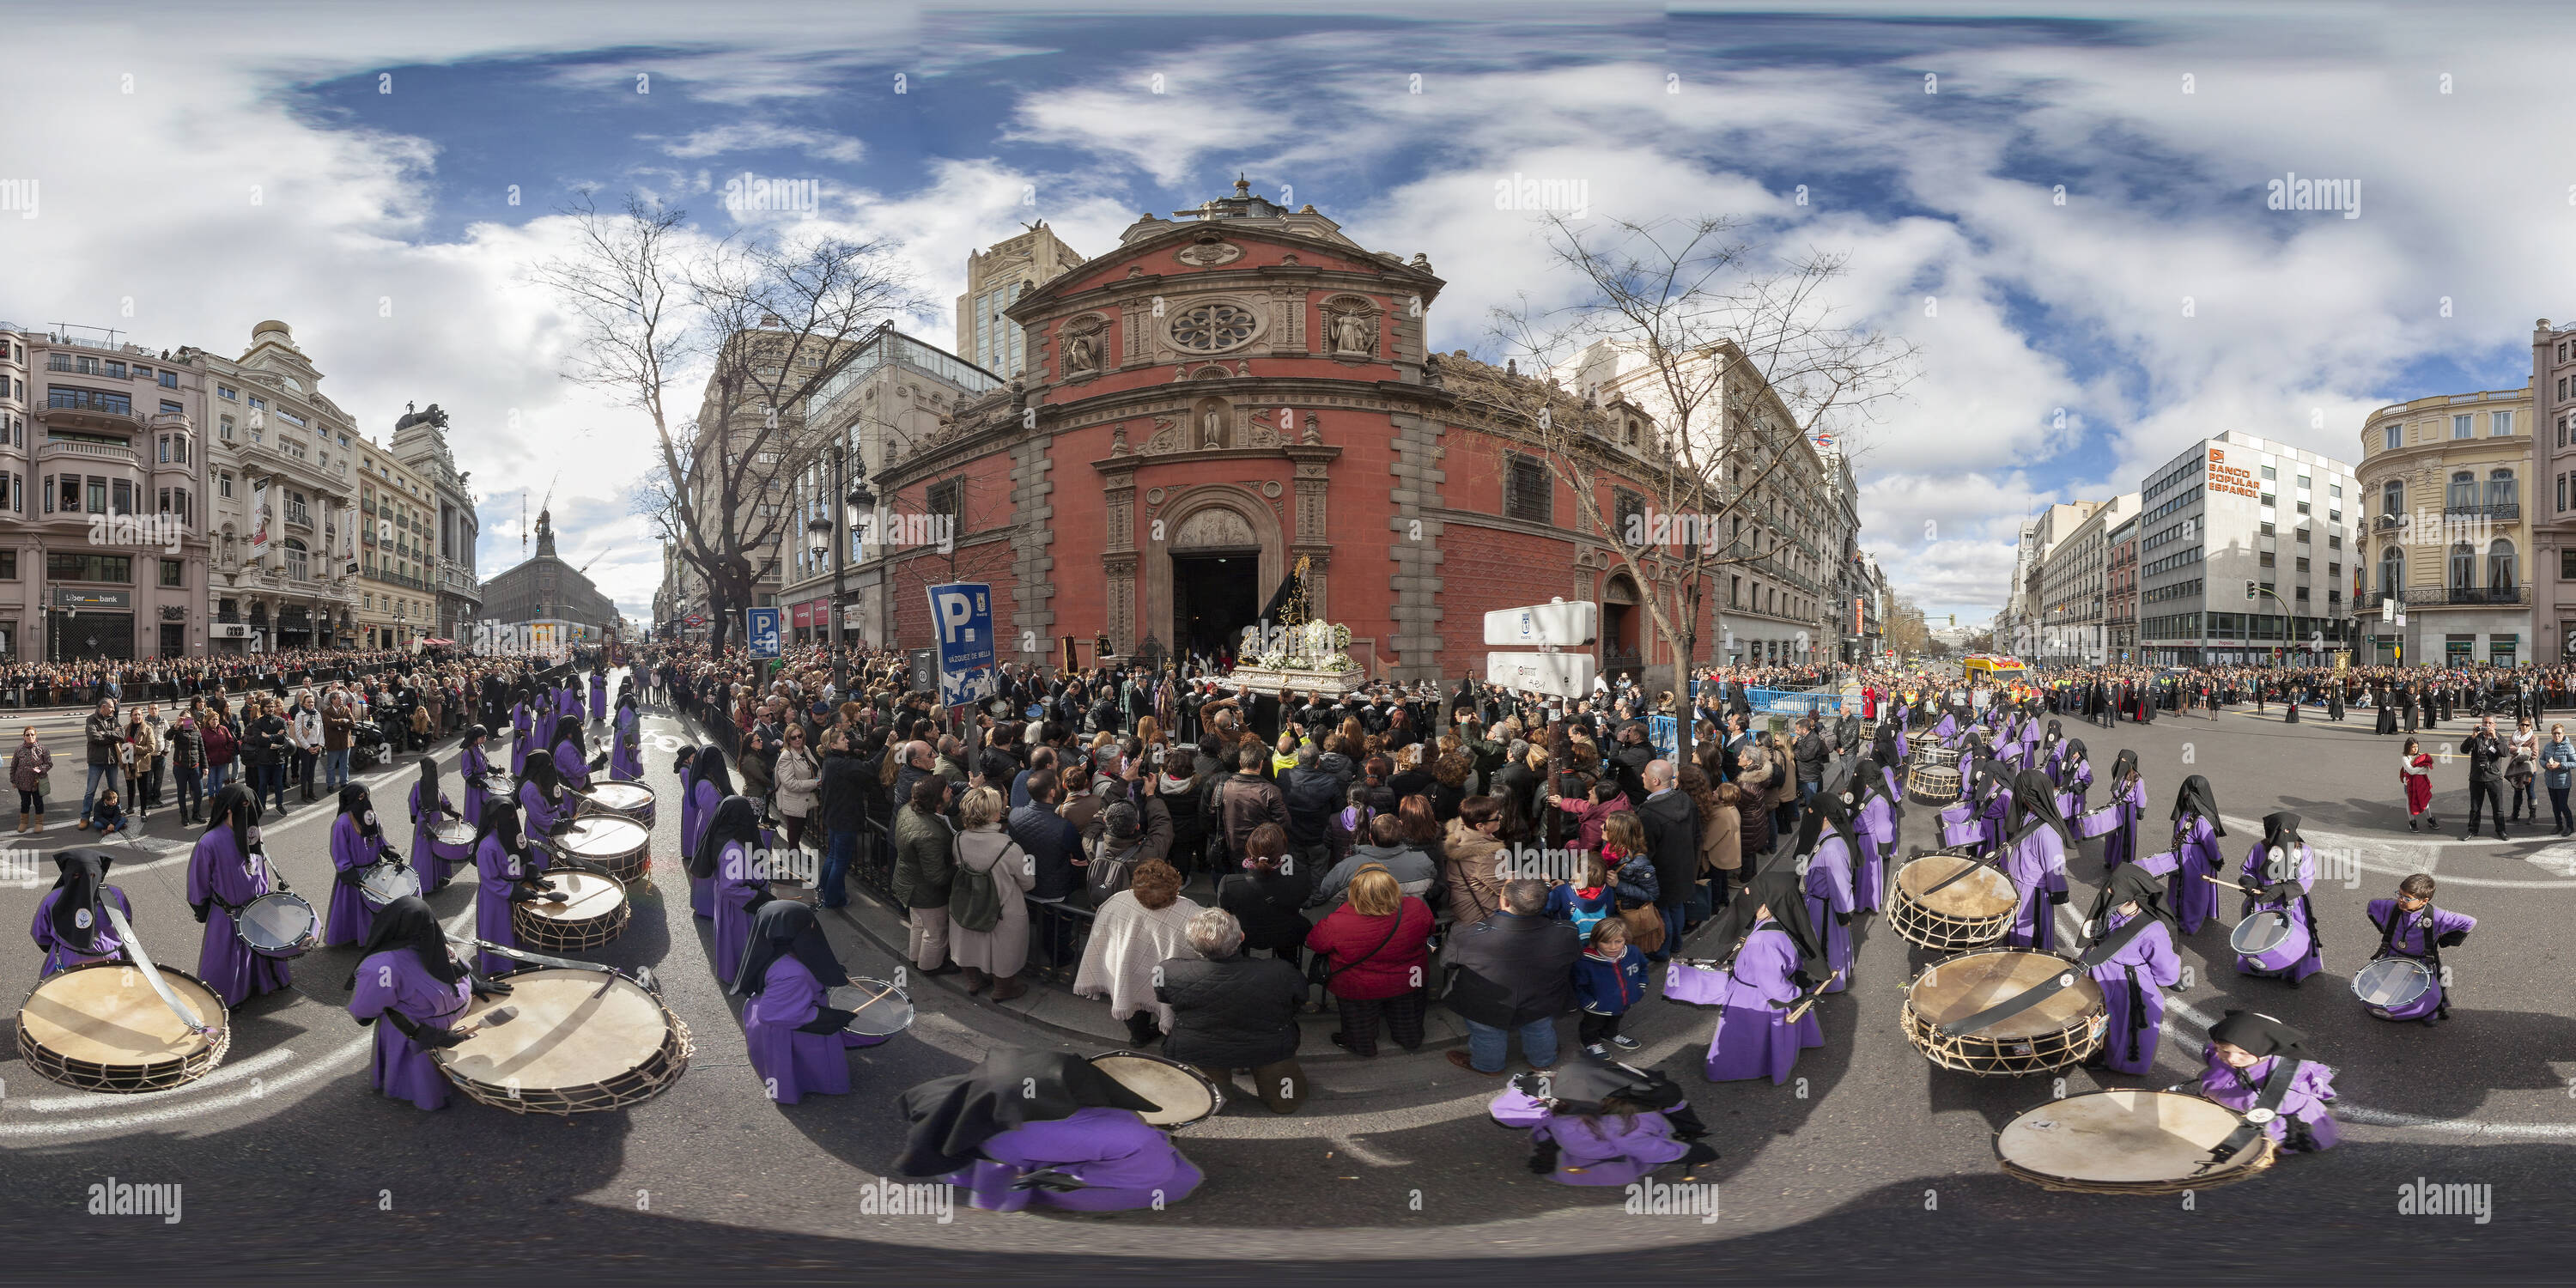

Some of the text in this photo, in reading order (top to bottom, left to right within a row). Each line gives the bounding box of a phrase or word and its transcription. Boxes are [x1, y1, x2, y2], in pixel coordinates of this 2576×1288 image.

[2209, 464, 2251, 478] BANCO
[2208, 472, 2260, 489] POPULAR
[757, 616, 771, 634] P
[938, 592, 972, 644] P
[1626, 963, 1639, 976] 75
